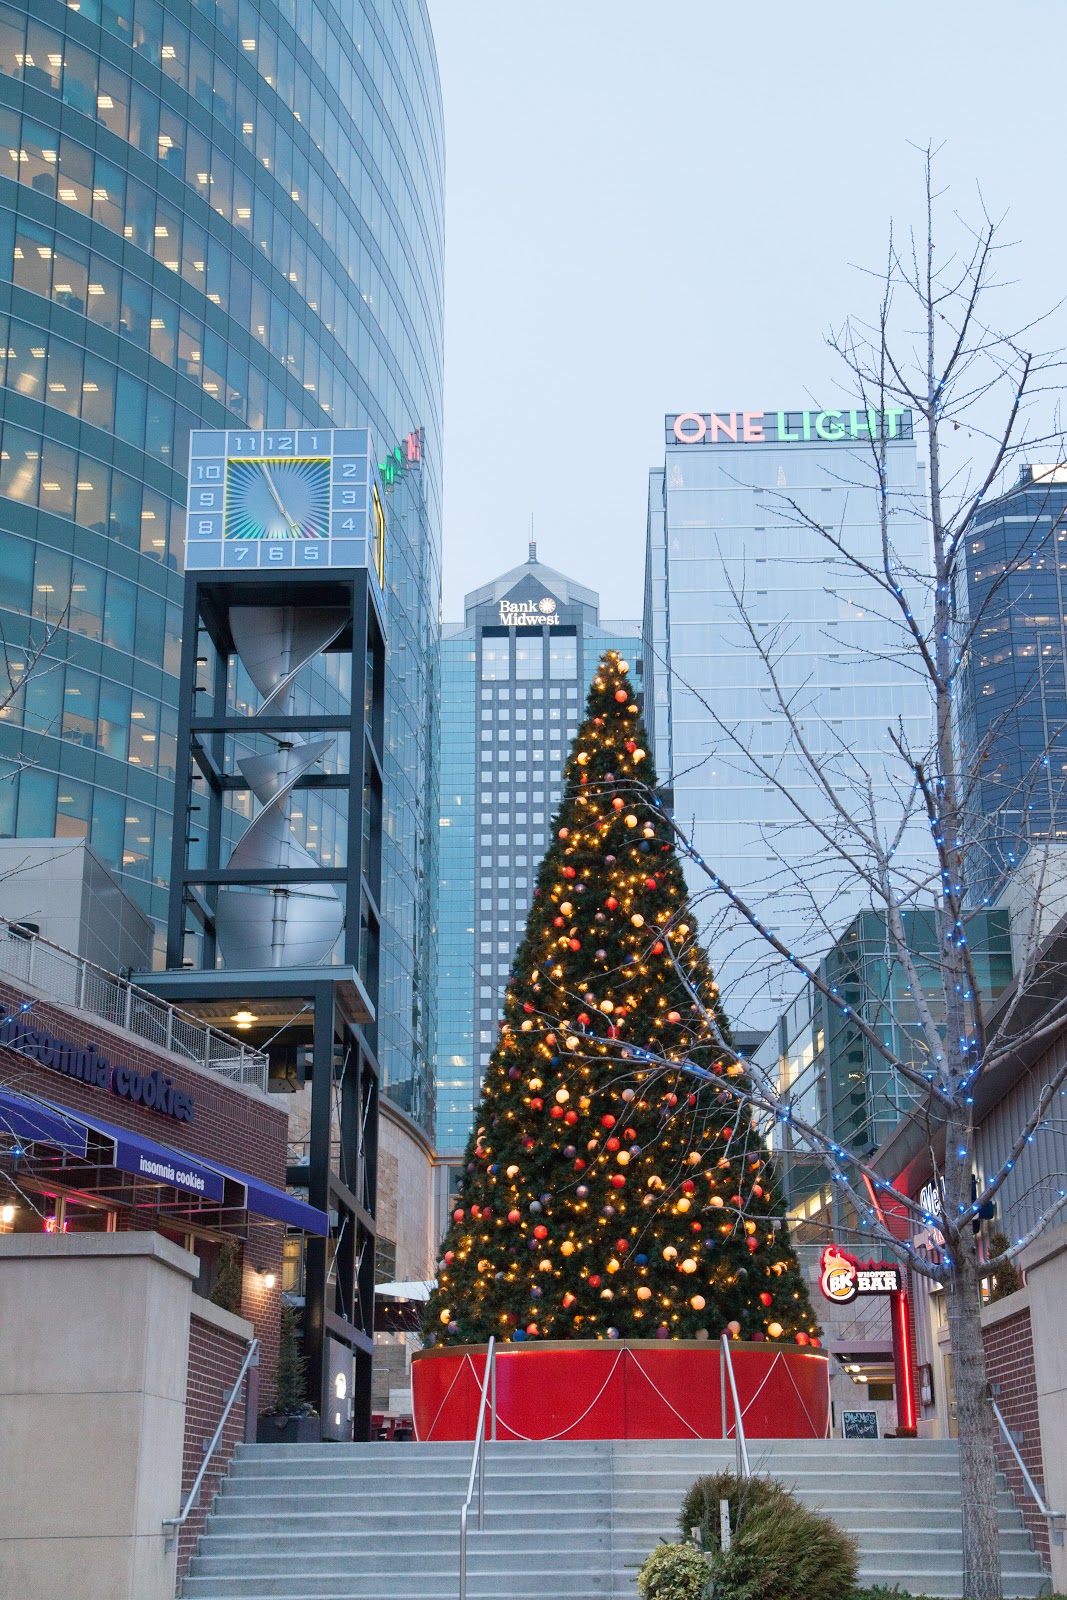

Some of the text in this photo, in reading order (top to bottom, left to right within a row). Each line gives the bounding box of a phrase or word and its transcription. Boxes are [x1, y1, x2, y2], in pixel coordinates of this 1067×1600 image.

[673, 408, 905, 443] ONE LIGHT
[235, 437, 256, 451] 11
[267, 437, 293, 450] 12
[311, 436, 318, 450] 1
[197, 466, 221, 479] 10
[342, 464, 357, 477] 2
[199, 493, 214, 507] 9
[342, 491, 356, 504] 3
[198, 521, 213, 534] 8
[341, 518, 355, 531] 4
[234, 548, 249, 561] 7
[268, 547, 284, 561] 6
[304, 547, 319, 560] 5
[499, 600, 538, 613] Bank
[499, 612, 560, 626] Midwest
[112, 1065, 195, 1123] cookies
[140, 1155, 205, 1191] insomnia cookies
[856, 1270, 896, 1278] WHOPPER
[830, 1272, 853, 1293] BK
[857, 1277, 898, 1291] BAR
